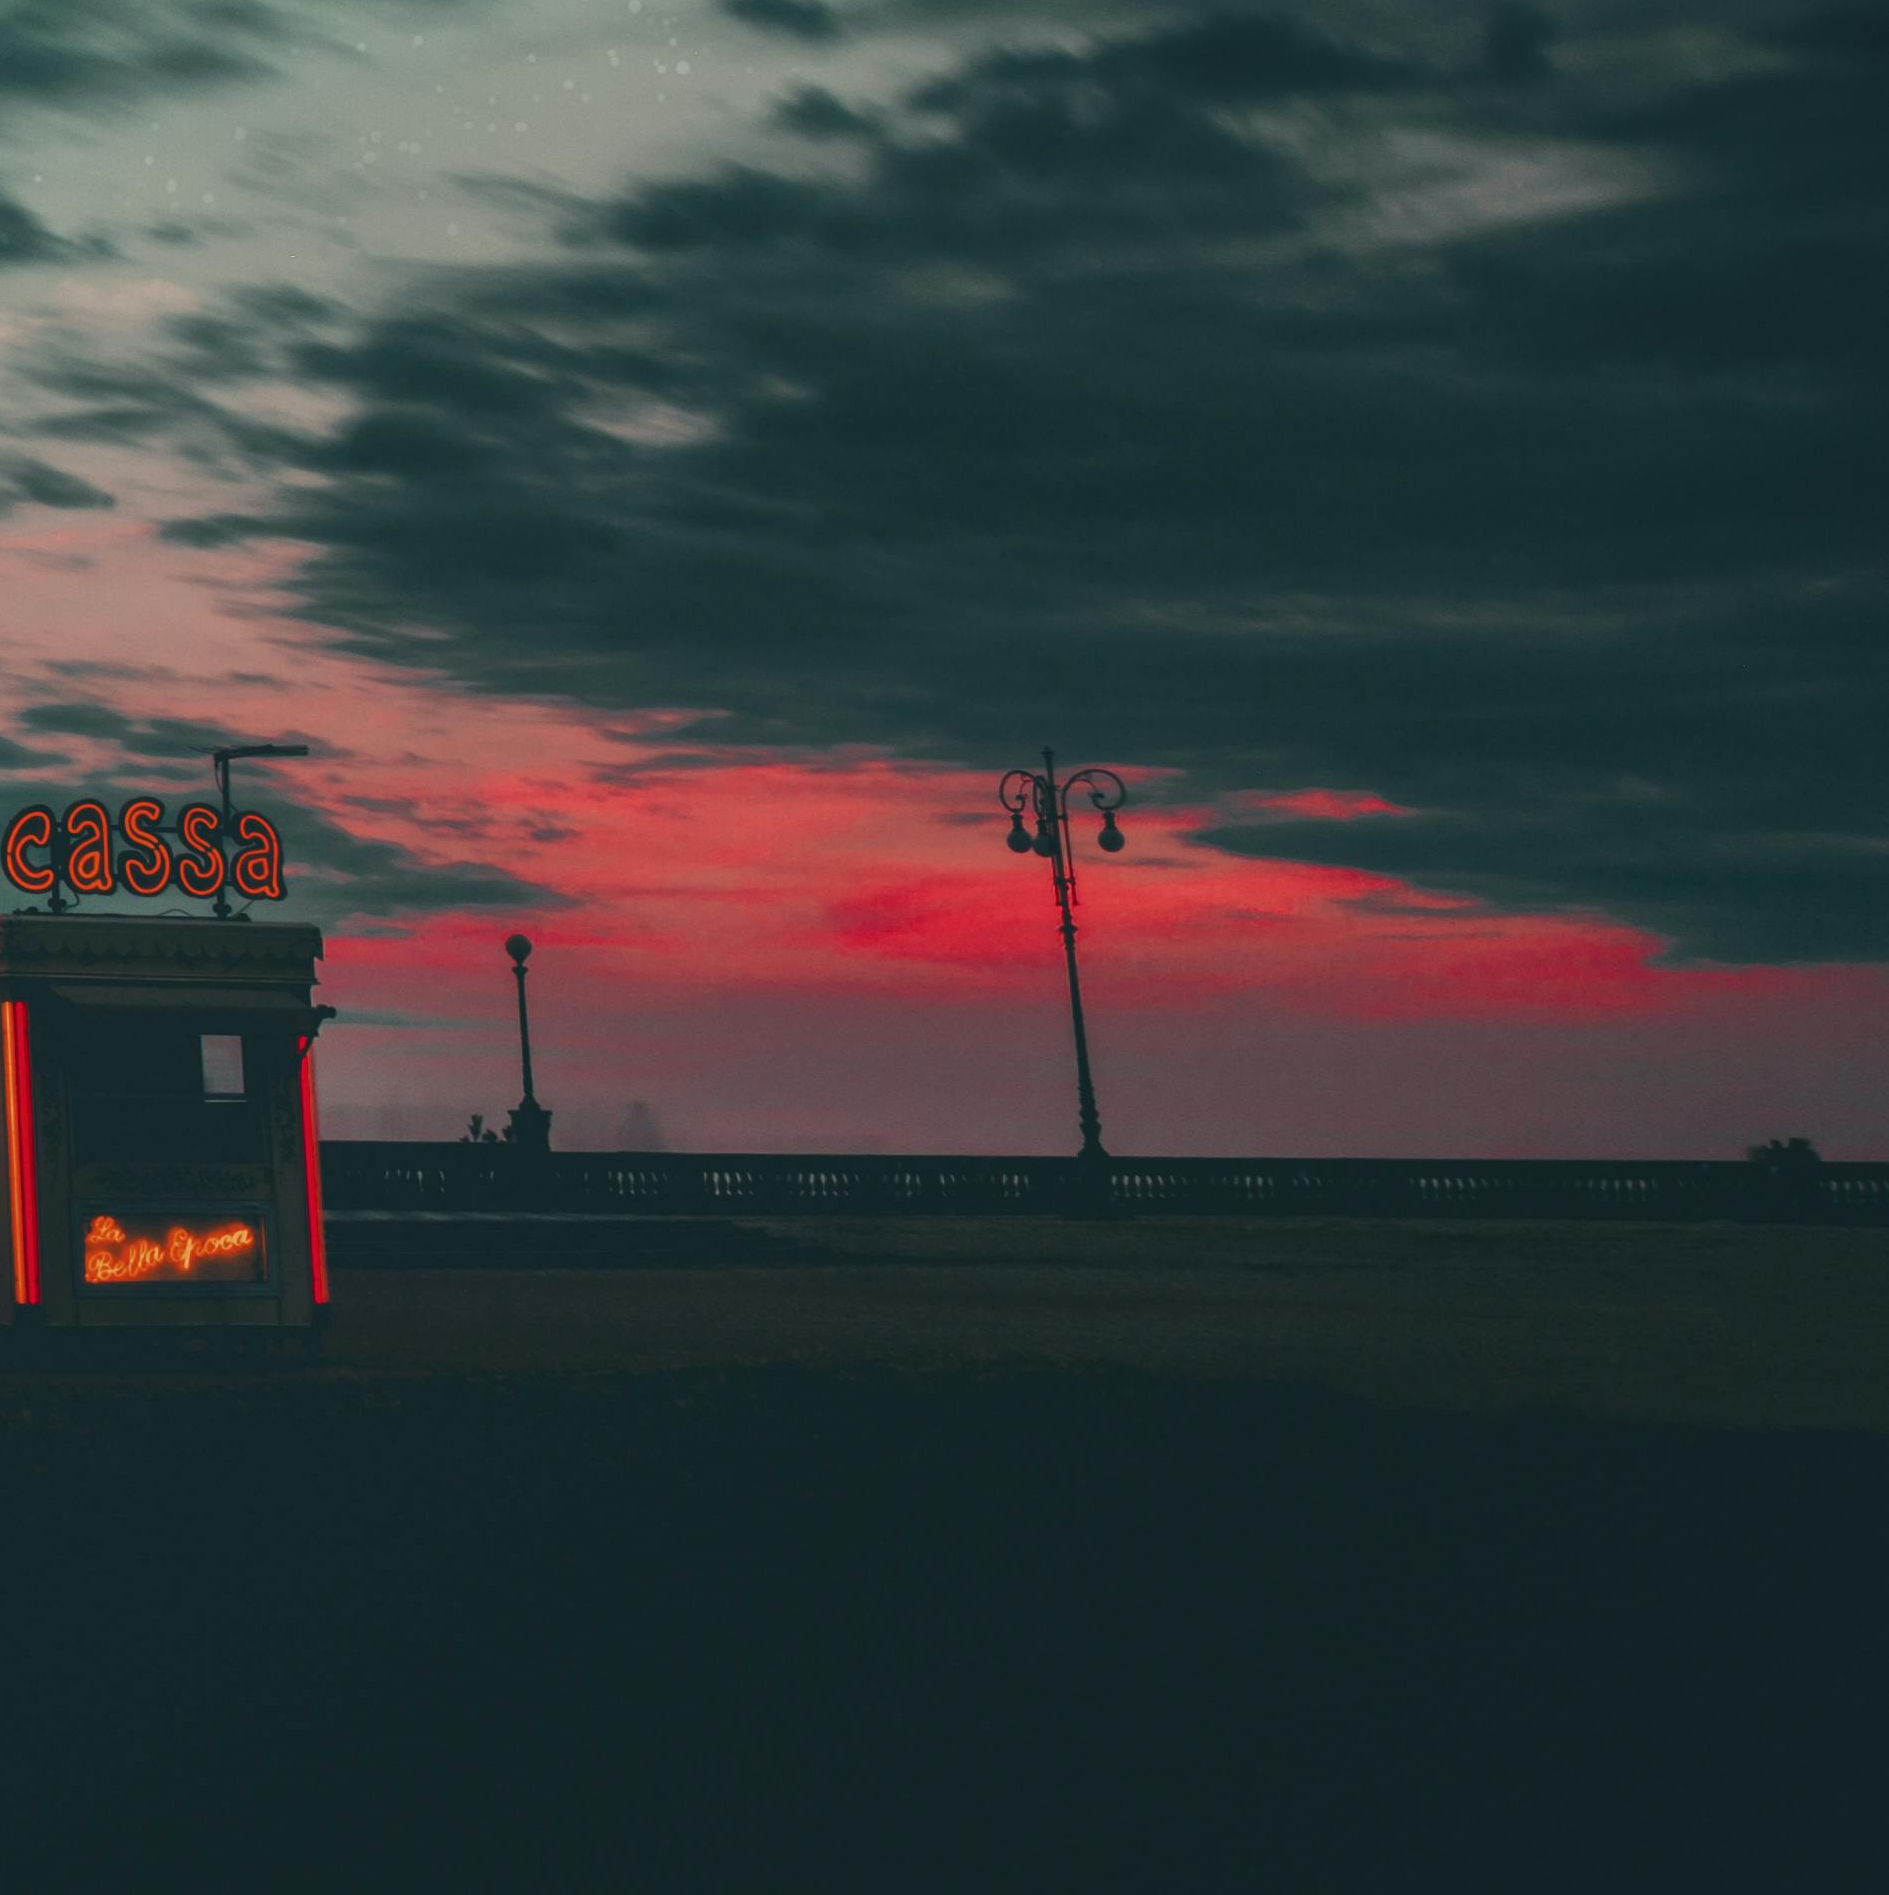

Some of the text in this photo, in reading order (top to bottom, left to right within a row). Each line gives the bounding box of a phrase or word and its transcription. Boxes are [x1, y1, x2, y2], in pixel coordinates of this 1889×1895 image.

[2, 798, 286, 900] cassa
[88, 1216, 124, 1243] La
[88, 1241, 164, 1280] Bella
